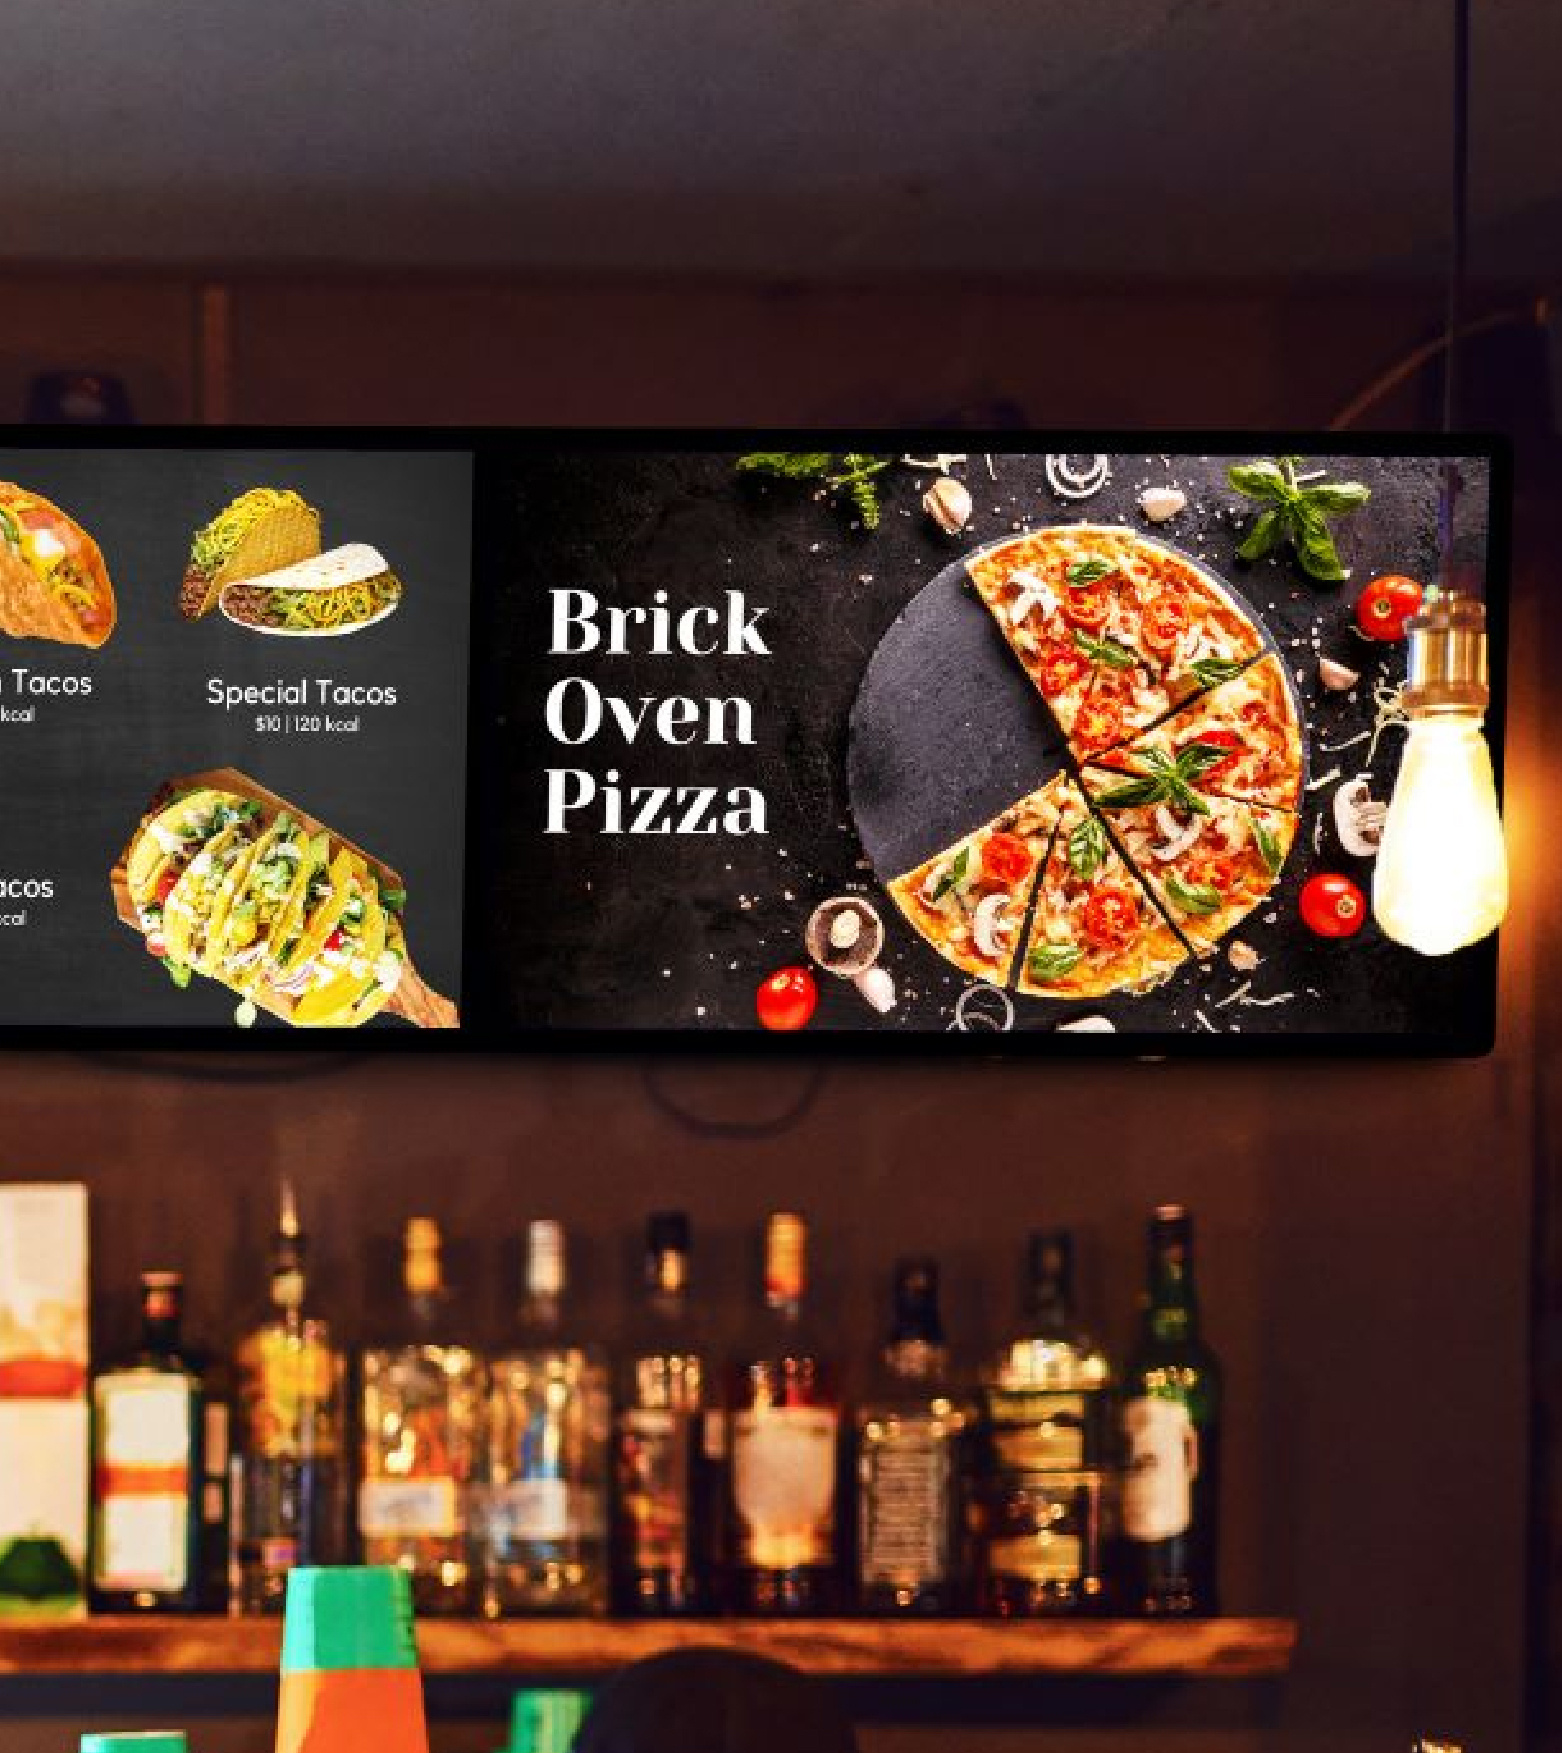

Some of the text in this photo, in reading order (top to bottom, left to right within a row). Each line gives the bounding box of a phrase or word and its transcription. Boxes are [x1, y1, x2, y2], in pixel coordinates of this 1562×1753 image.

[548, 589, 772, 655] Brick
[12, 669, 91, 695] Tacos
[206, 677, 396, 710] Special Tacos
[1, 705, 35, 721] kcal
[255, 715, 280, 731] $10
[296, 715, 321, 731] 120
[326, 715, 360, 731] kcal
[545, 676, 757, 745] Oven
[543, 768, 770, 834] Pizza
